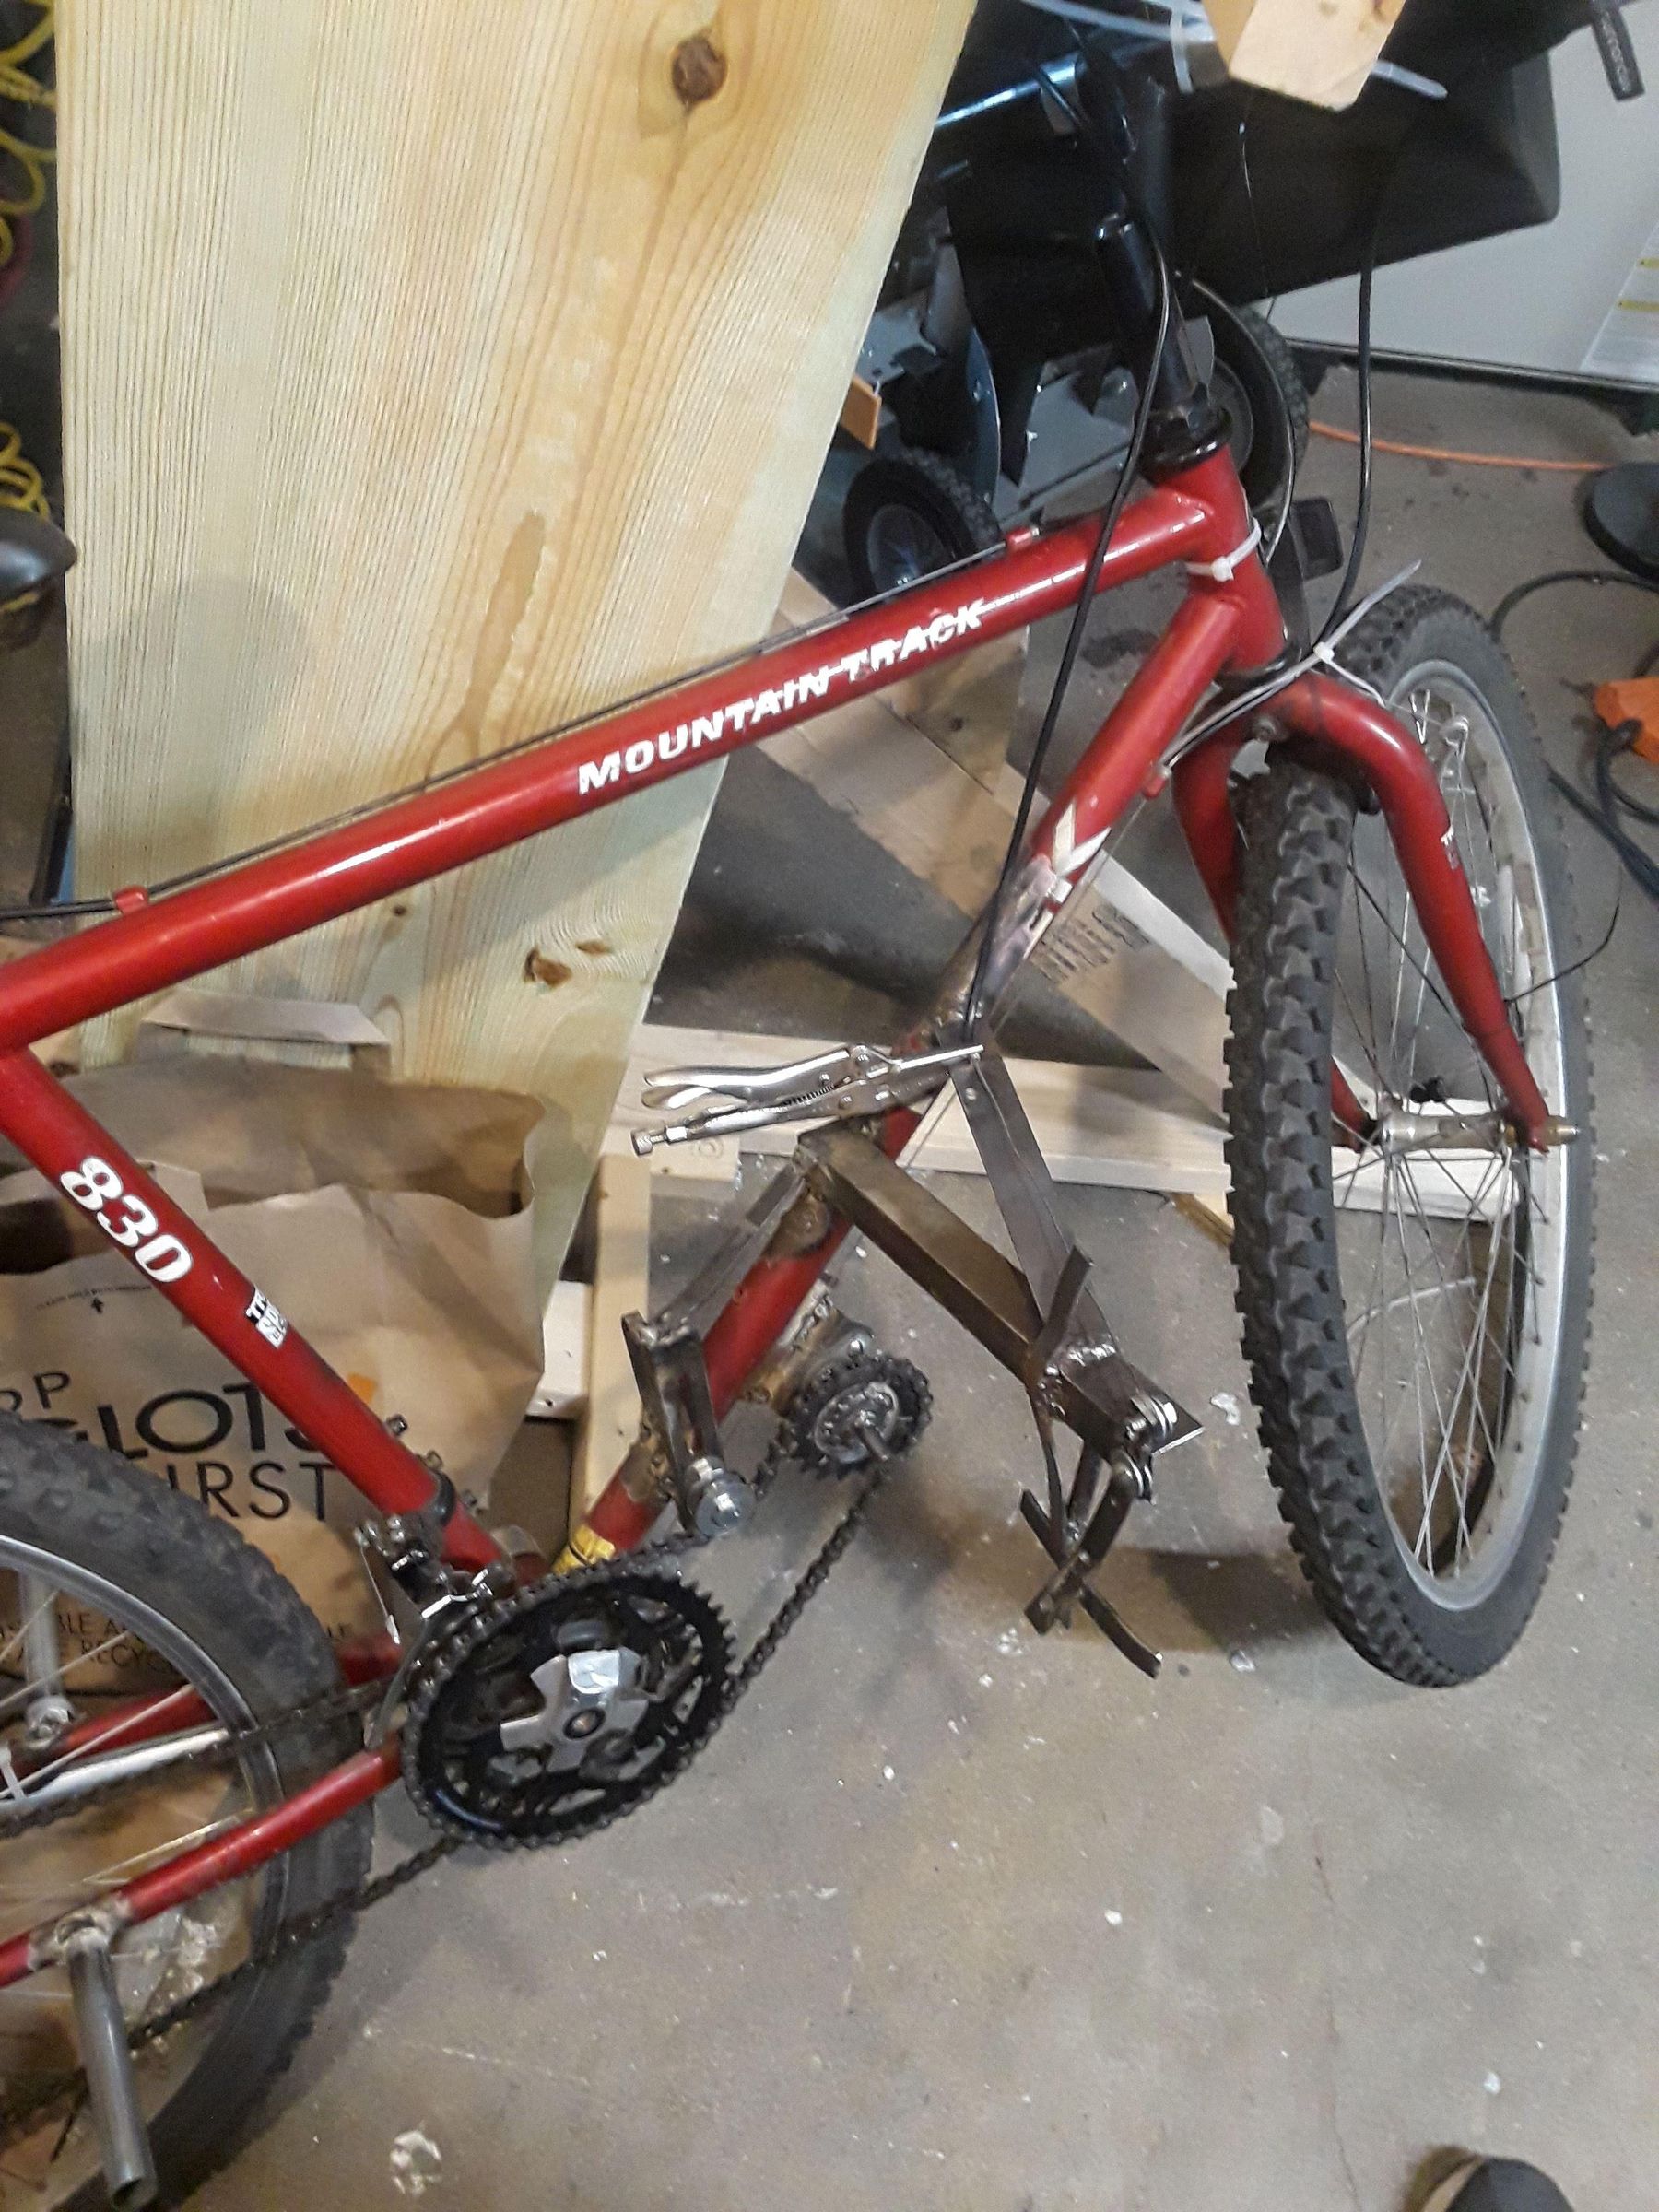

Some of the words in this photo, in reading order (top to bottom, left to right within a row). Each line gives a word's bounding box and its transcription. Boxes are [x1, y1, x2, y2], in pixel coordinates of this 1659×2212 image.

[577, 665, 831, 794] MOUNTAIN
[841, 596, 986, 683] TRACK
[60, 1156, 194, 1283] 830
[98, 1382, 323, 1459] LOT
[167, 1461, 337, 1522] IRST
